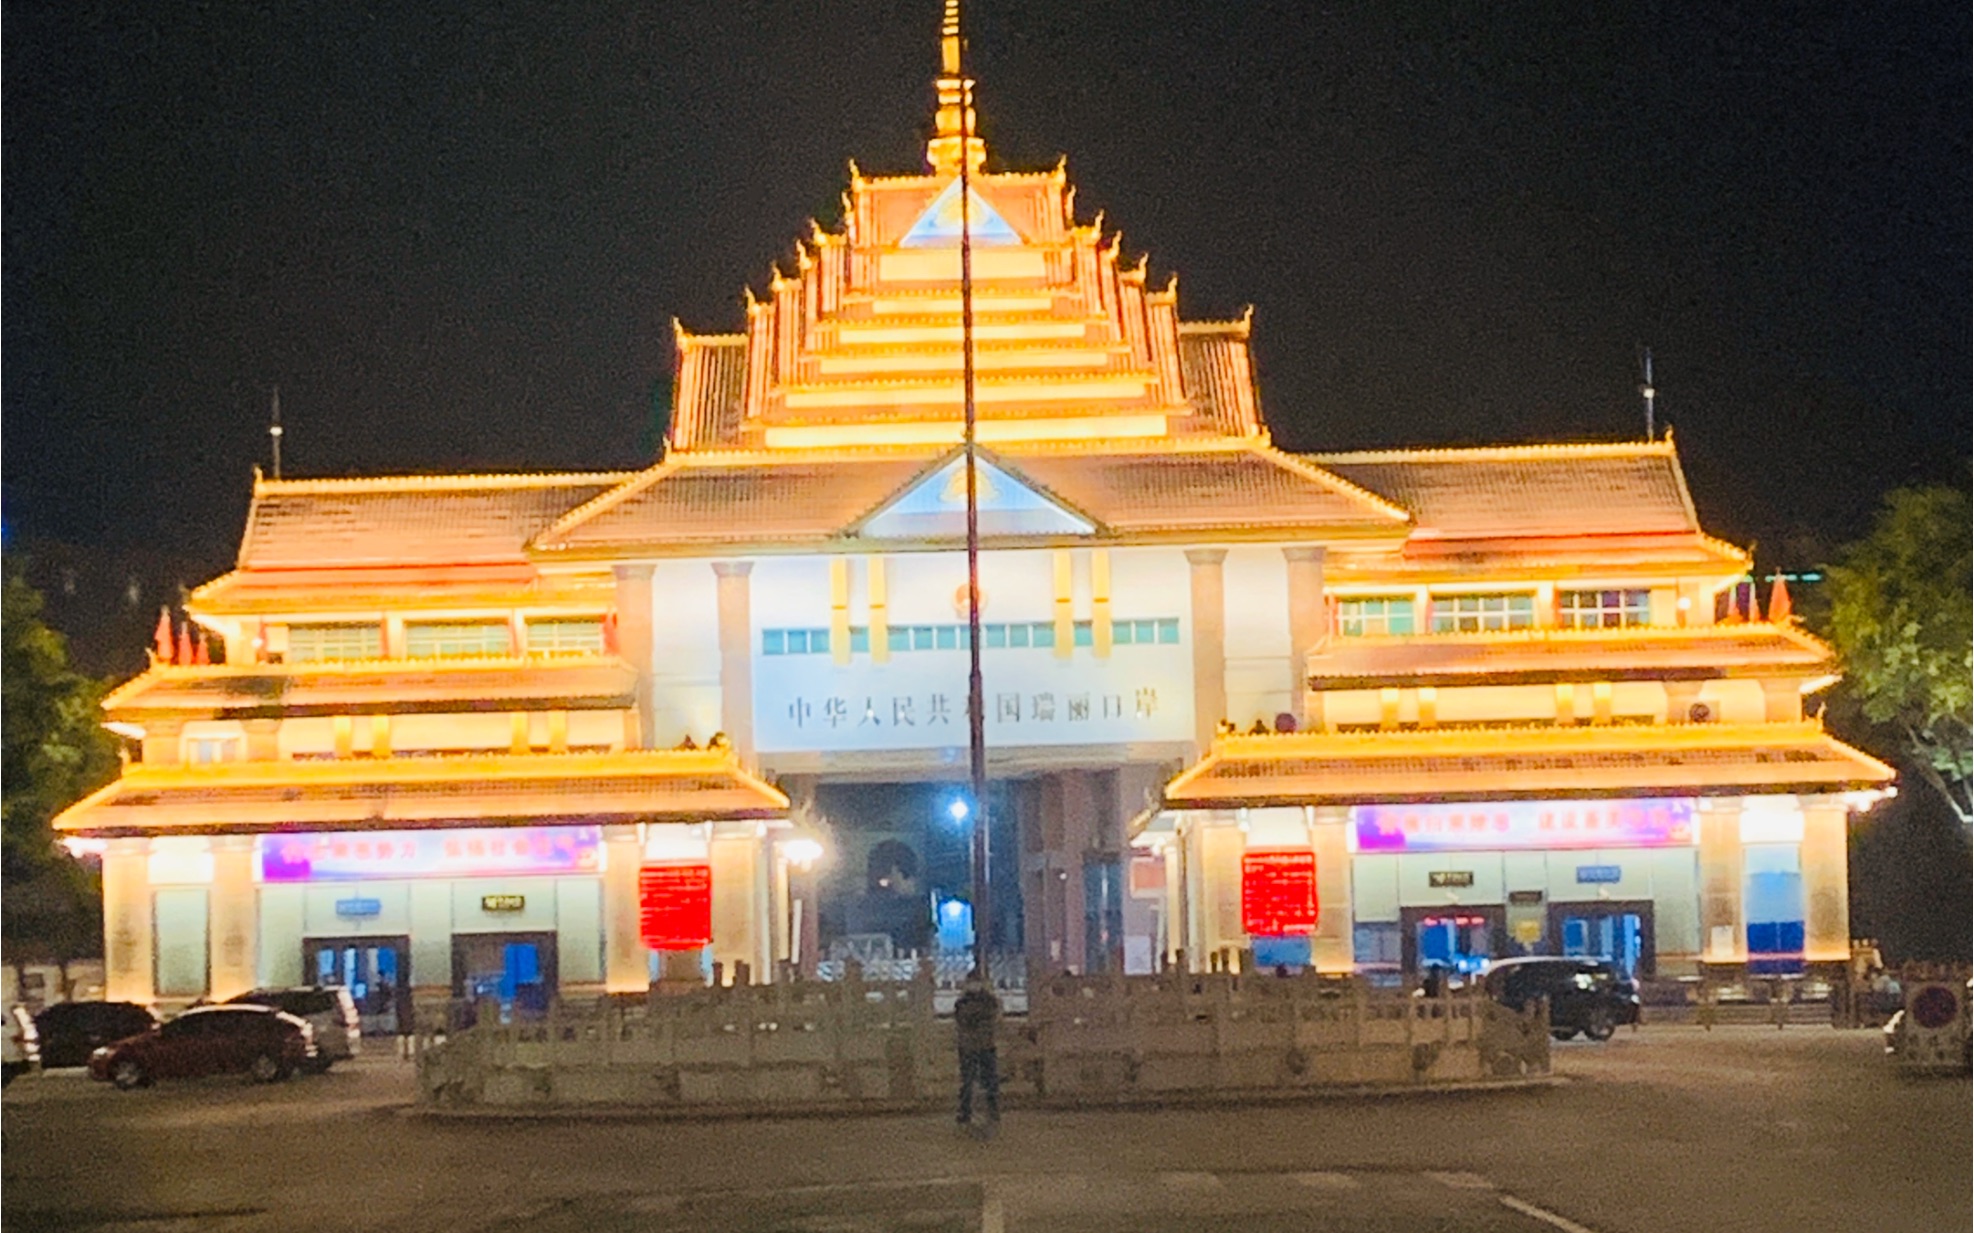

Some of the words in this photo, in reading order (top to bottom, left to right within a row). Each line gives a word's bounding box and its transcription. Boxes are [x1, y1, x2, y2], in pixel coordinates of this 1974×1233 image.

[788, 687, 1159, 728] 中华人民共国瑞丽口岸
